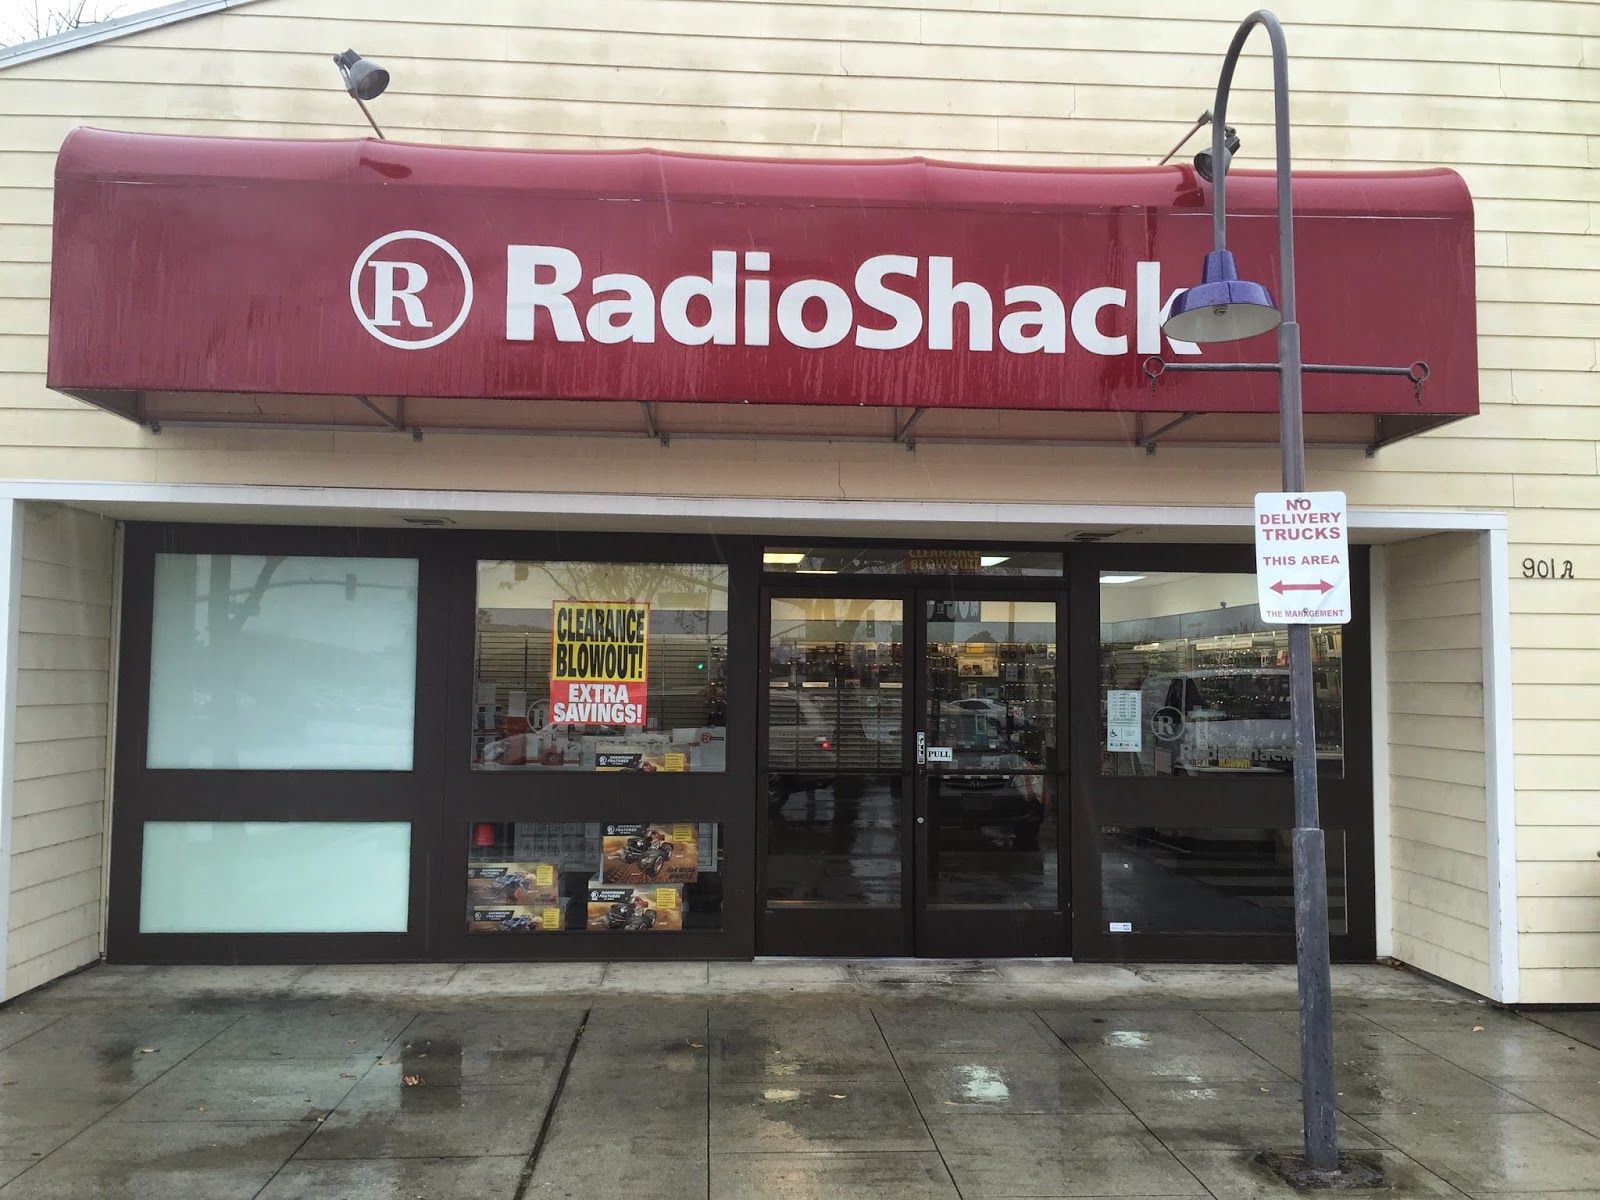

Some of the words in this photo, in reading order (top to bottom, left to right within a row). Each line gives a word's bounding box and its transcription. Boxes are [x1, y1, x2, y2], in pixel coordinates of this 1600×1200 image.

[506, 244, 1202, 356] RadioShack
[1286, 498, 1312, 511] NO
[1259, 511, 1341, 525] DELIVERY
[1262, 527, 1341, 541] TRUCKS
[1263, 555, 1297, 566] THIS
[1301, 554, 1341, 565] AREA
[1266, 610, 1283, 618] THE
[1284, 609, 1345, 618] MANAGEMENT
[556, 606, 645, 644] CLEARANCE
[556, 642, 644, 679] BLOWOUT!
[568, 683, 630, 704] EXTRA
[553, 702, 643, 724] SAVINGS!
[928, 750, 951, 758] PULL
